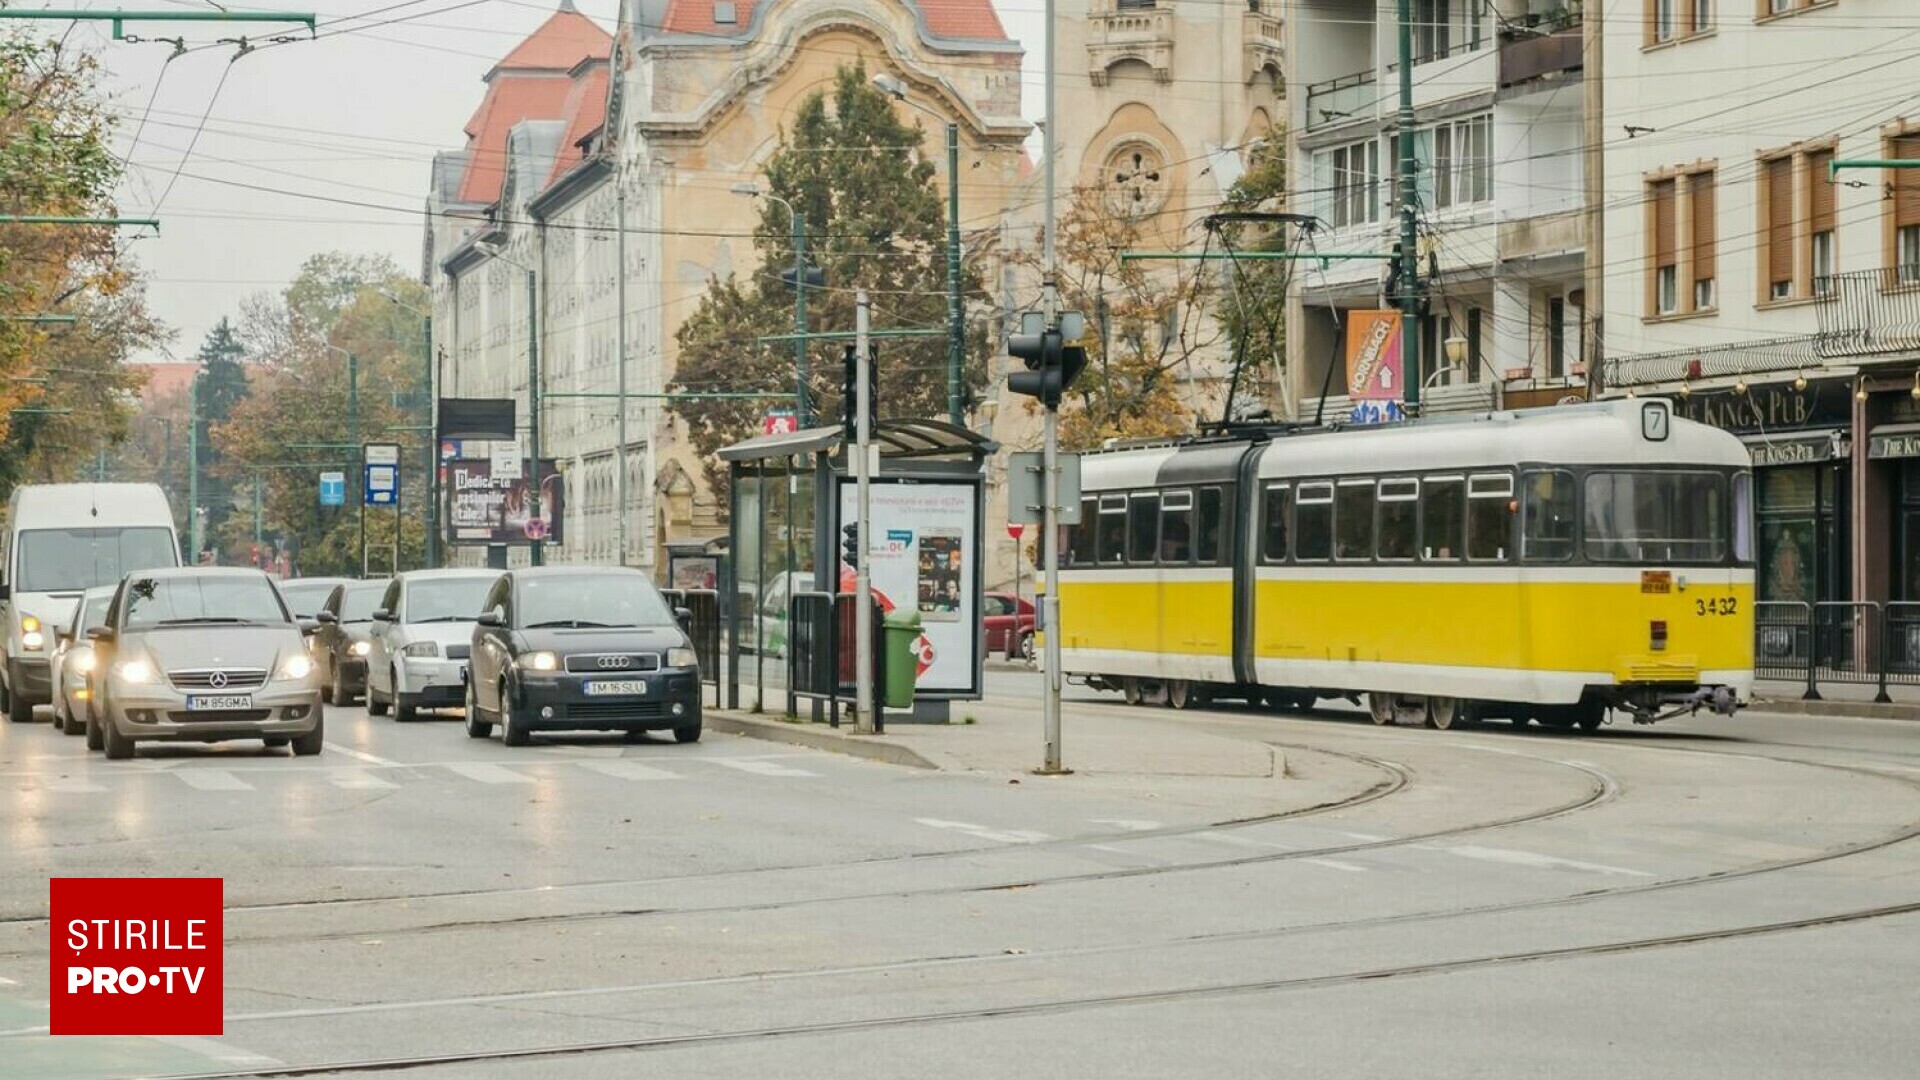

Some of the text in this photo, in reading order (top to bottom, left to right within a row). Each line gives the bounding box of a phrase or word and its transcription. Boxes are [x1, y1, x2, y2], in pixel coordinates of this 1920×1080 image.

[1351, 319, 1391, 394] HORNBACH
[1769, 390, 1806, 425] PUB
[1650, 411, 1661, 431] 7
[1796, 443, 1814, 460] PUB
[1883, 439, 1903, 456] THE
[1696, 597, 1737, 616] 3432
[592, 683, 607, 694] TM
[195, 698, 208, 708] TM
